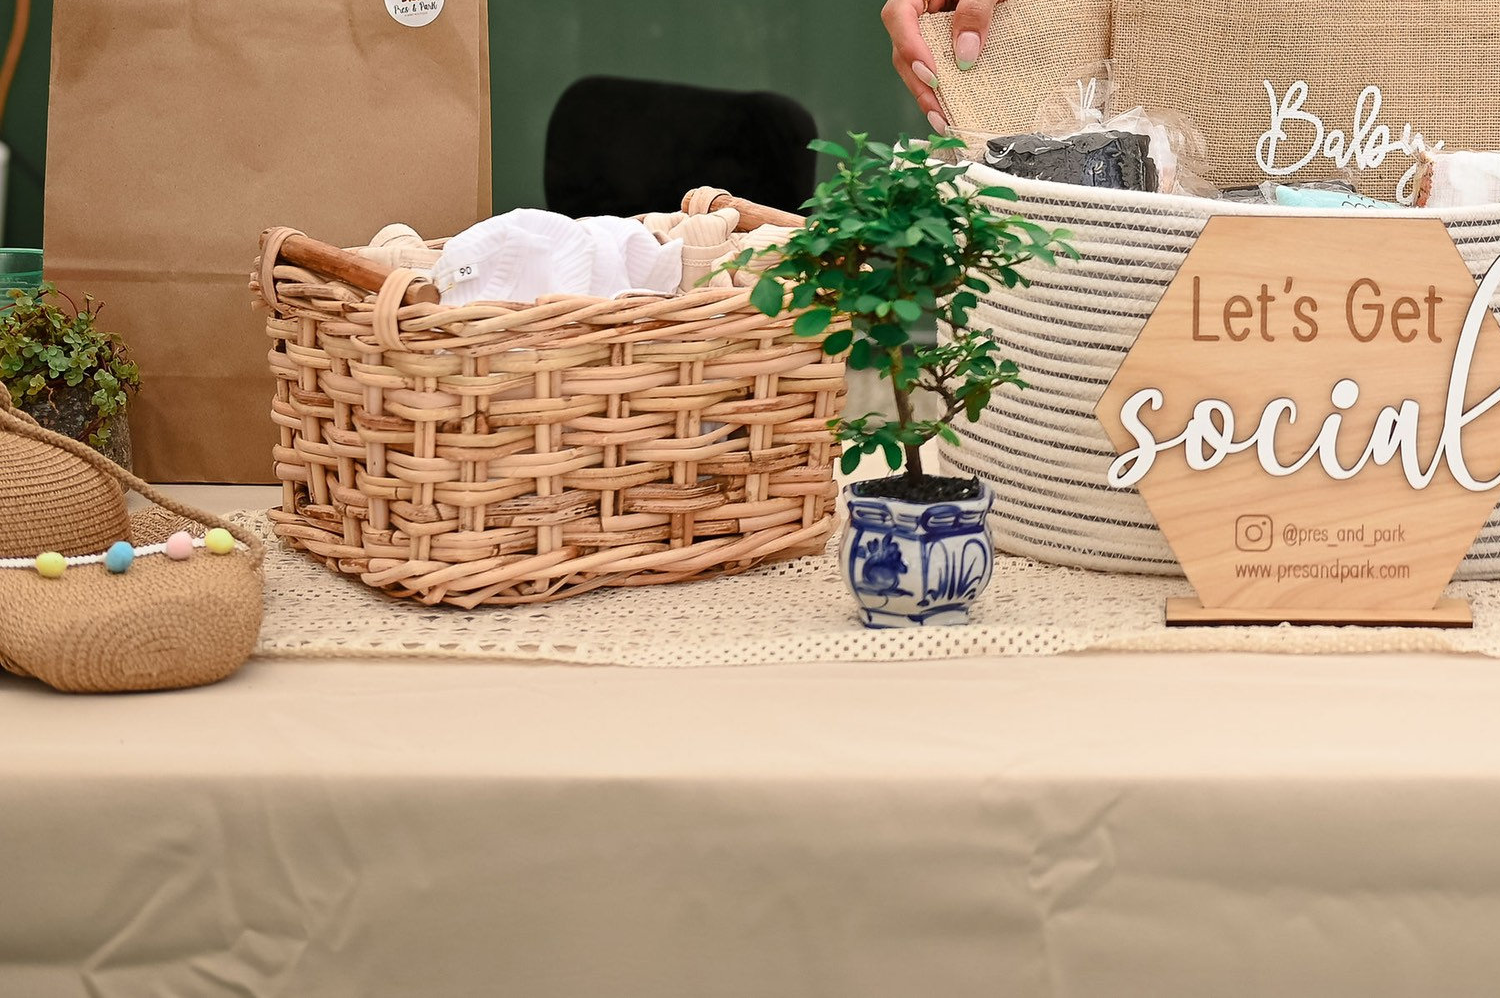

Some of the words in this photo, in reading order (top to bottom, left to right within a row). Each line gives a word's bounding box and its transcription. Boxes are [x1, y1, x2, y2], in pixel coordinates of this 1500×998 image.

[393, 4, 409, 15] Pres
[1256, 79, 1445, 204] Baby
[459, 266, 473, 277] 90
[1192, 275, 1319, 342] Let's
[1345, 277, 1443, 343] Get
[1282, 523, 1405, 548] @pres_and_park
[1235, 558, 1410, 583] www.presandpark.com
